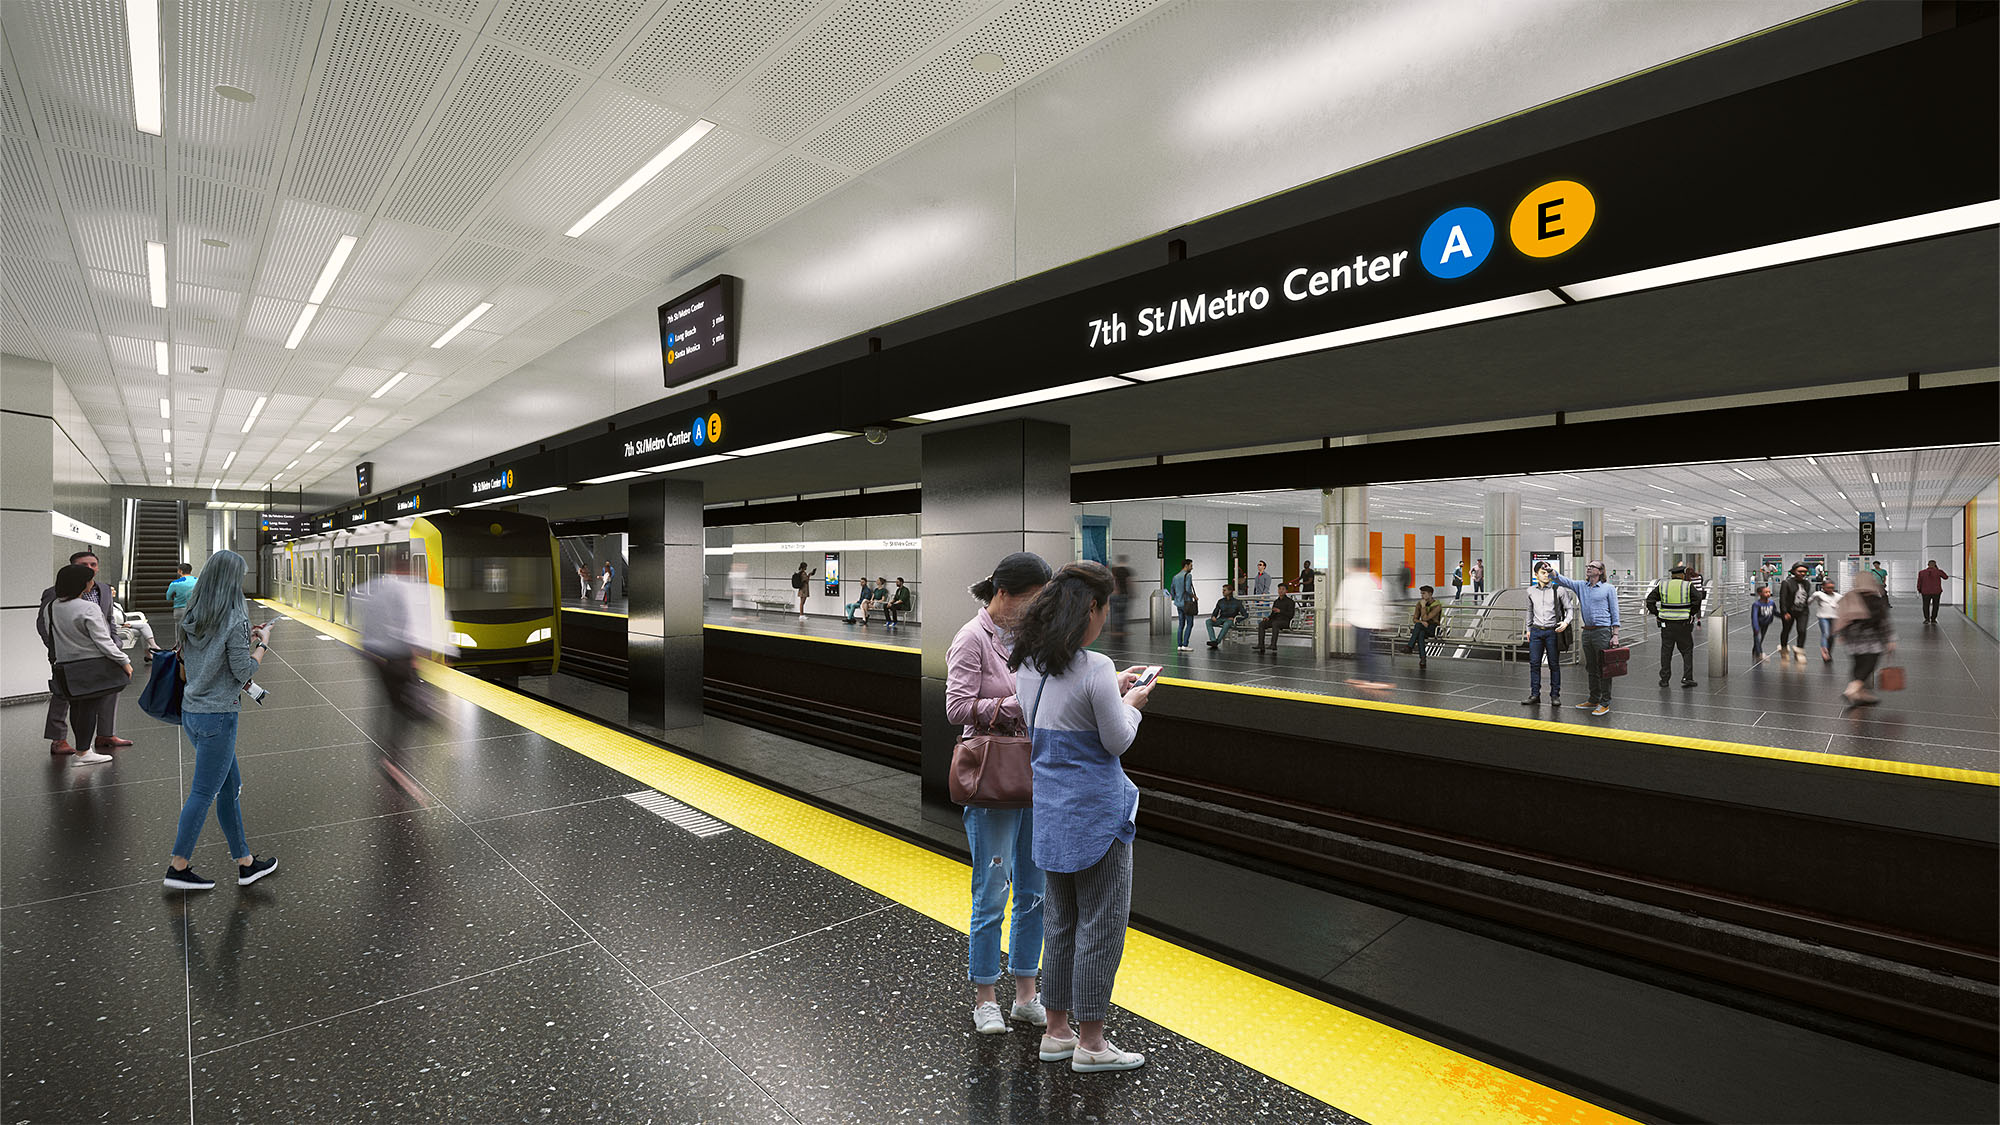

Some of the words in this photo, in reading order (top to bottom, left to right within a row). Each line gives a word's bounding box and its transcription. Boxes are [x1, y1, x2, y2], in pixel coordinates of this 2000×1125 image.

[1088, 315, 1127, 349] 7th
[1137, 286, 1269, 337] St/Metro
[1283, 249, 1409, 301] Center
[1439, 225, 1473, 264] A
[1537, 198, 1565, 240] E
[675, 334, 684, 342] Long
[685, 325, 697, 337] Beach
[675, 350, 685, 359] Santa
[686, 343, 700, 354] Monica
[624, 441, 635, 457] 7th
[635, 437, 665, 455] St/Metro
[666, 430, 691, 447] Center
